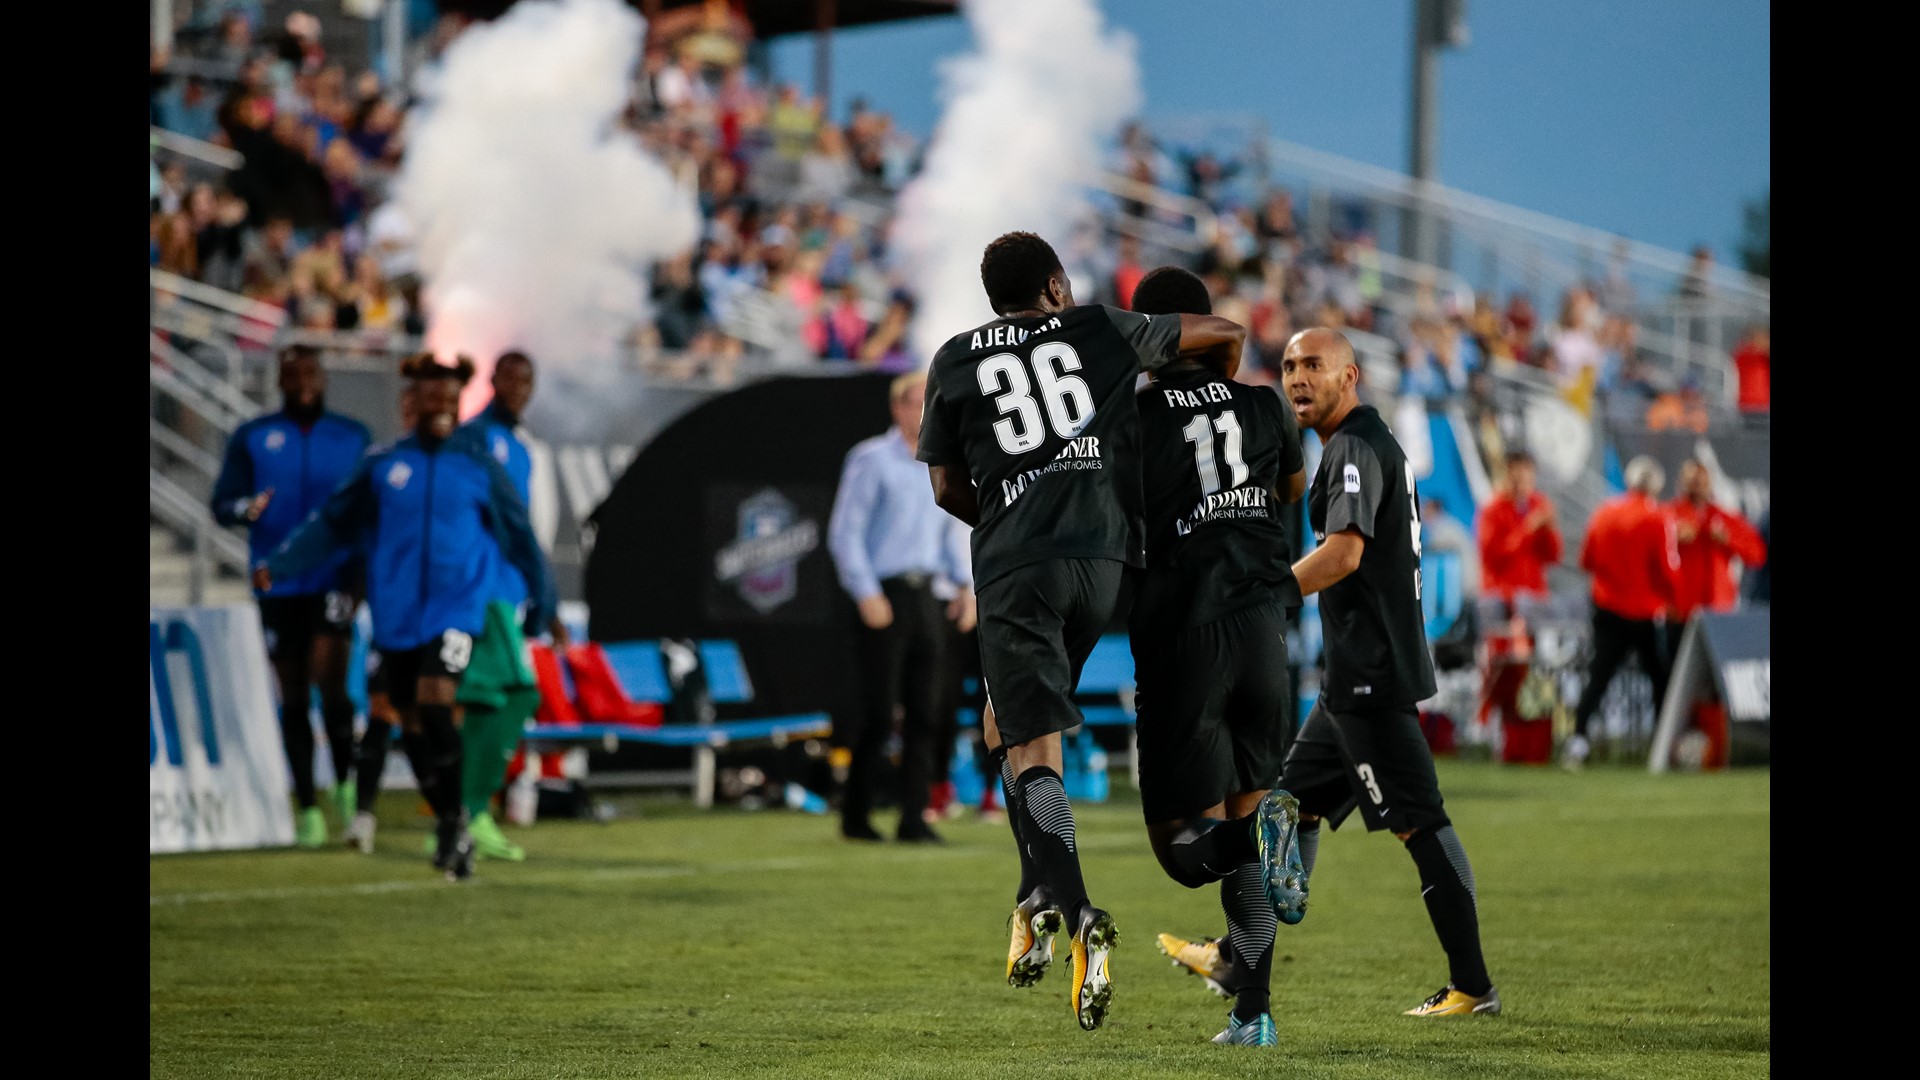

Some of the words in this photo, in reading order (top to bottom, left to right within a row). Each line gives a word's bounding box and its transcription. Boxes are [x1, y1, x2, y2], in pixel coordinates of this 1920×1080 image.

[977, 341, 1097, 455] 36
[1163, 382, 1233, 408] FRATER
[1183, 410, 1249, 497] 11
[1237, 508, 1268, 519] HOMES
[1358, 763, 1383, 805] 3
